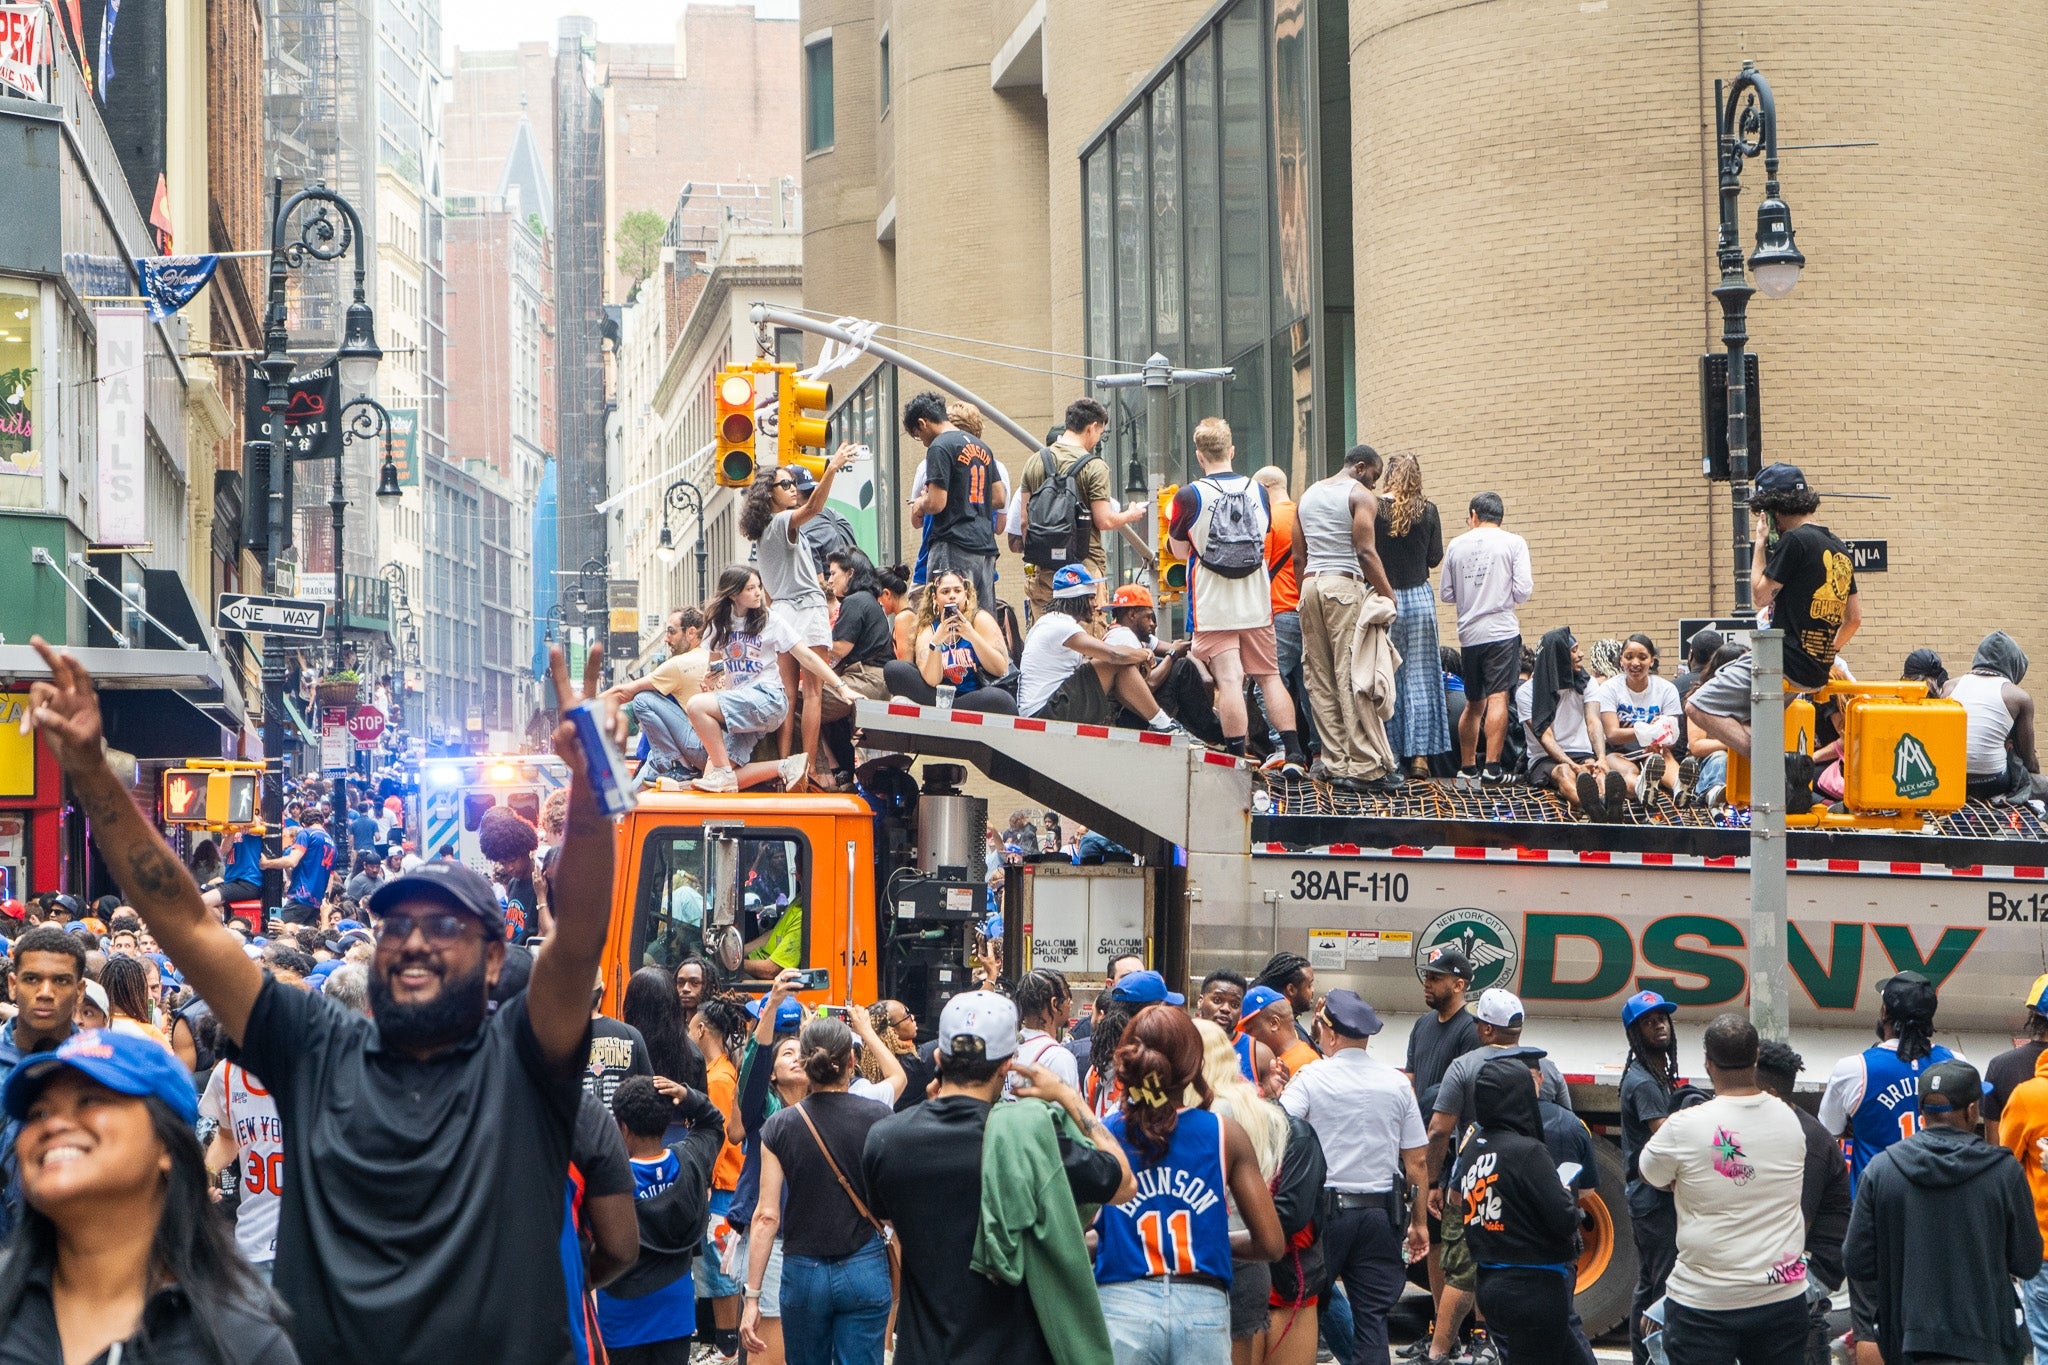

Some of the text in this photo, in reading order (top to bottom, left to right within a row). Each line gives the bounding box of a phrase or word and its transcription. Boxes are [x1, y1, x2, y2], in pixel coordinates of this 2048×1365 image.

[0, 10, 37, 66] PEN
[106, 340, 134, 502] NAILS
[261, 421, 328, 437] OANI
[969, 464, 985, 504] 11
[1867, 548, 1881, 560] LA
[230, 606, 315, 626] ONE WAY
[726, 659, 764, 674] NICKS
[349, 716, 383, 731] STOP
[1899, 779, 1936, 793] ALEX MOSS
[1044, 867, 1062, 875] FILL
[1118, 867, 1136, 875] FILL
[1290, 870, 1409, 902] 38AF-110
[1436, 911, 1504, 932] NEW YORK CITY
[1034, 939, 1076, 947] CALCIUM
[1100, 938, 1142, 946] CALCIUM
[1032, 947, 1079, 955] CHLORIDE
[1097, 946, 1144, 955] CHLORIDE
[1043, 955, 1068, 963] ONLY
[1519, 911, 1987, 1012] DSNY
[1136, 1209, 1199, 1276] 11
